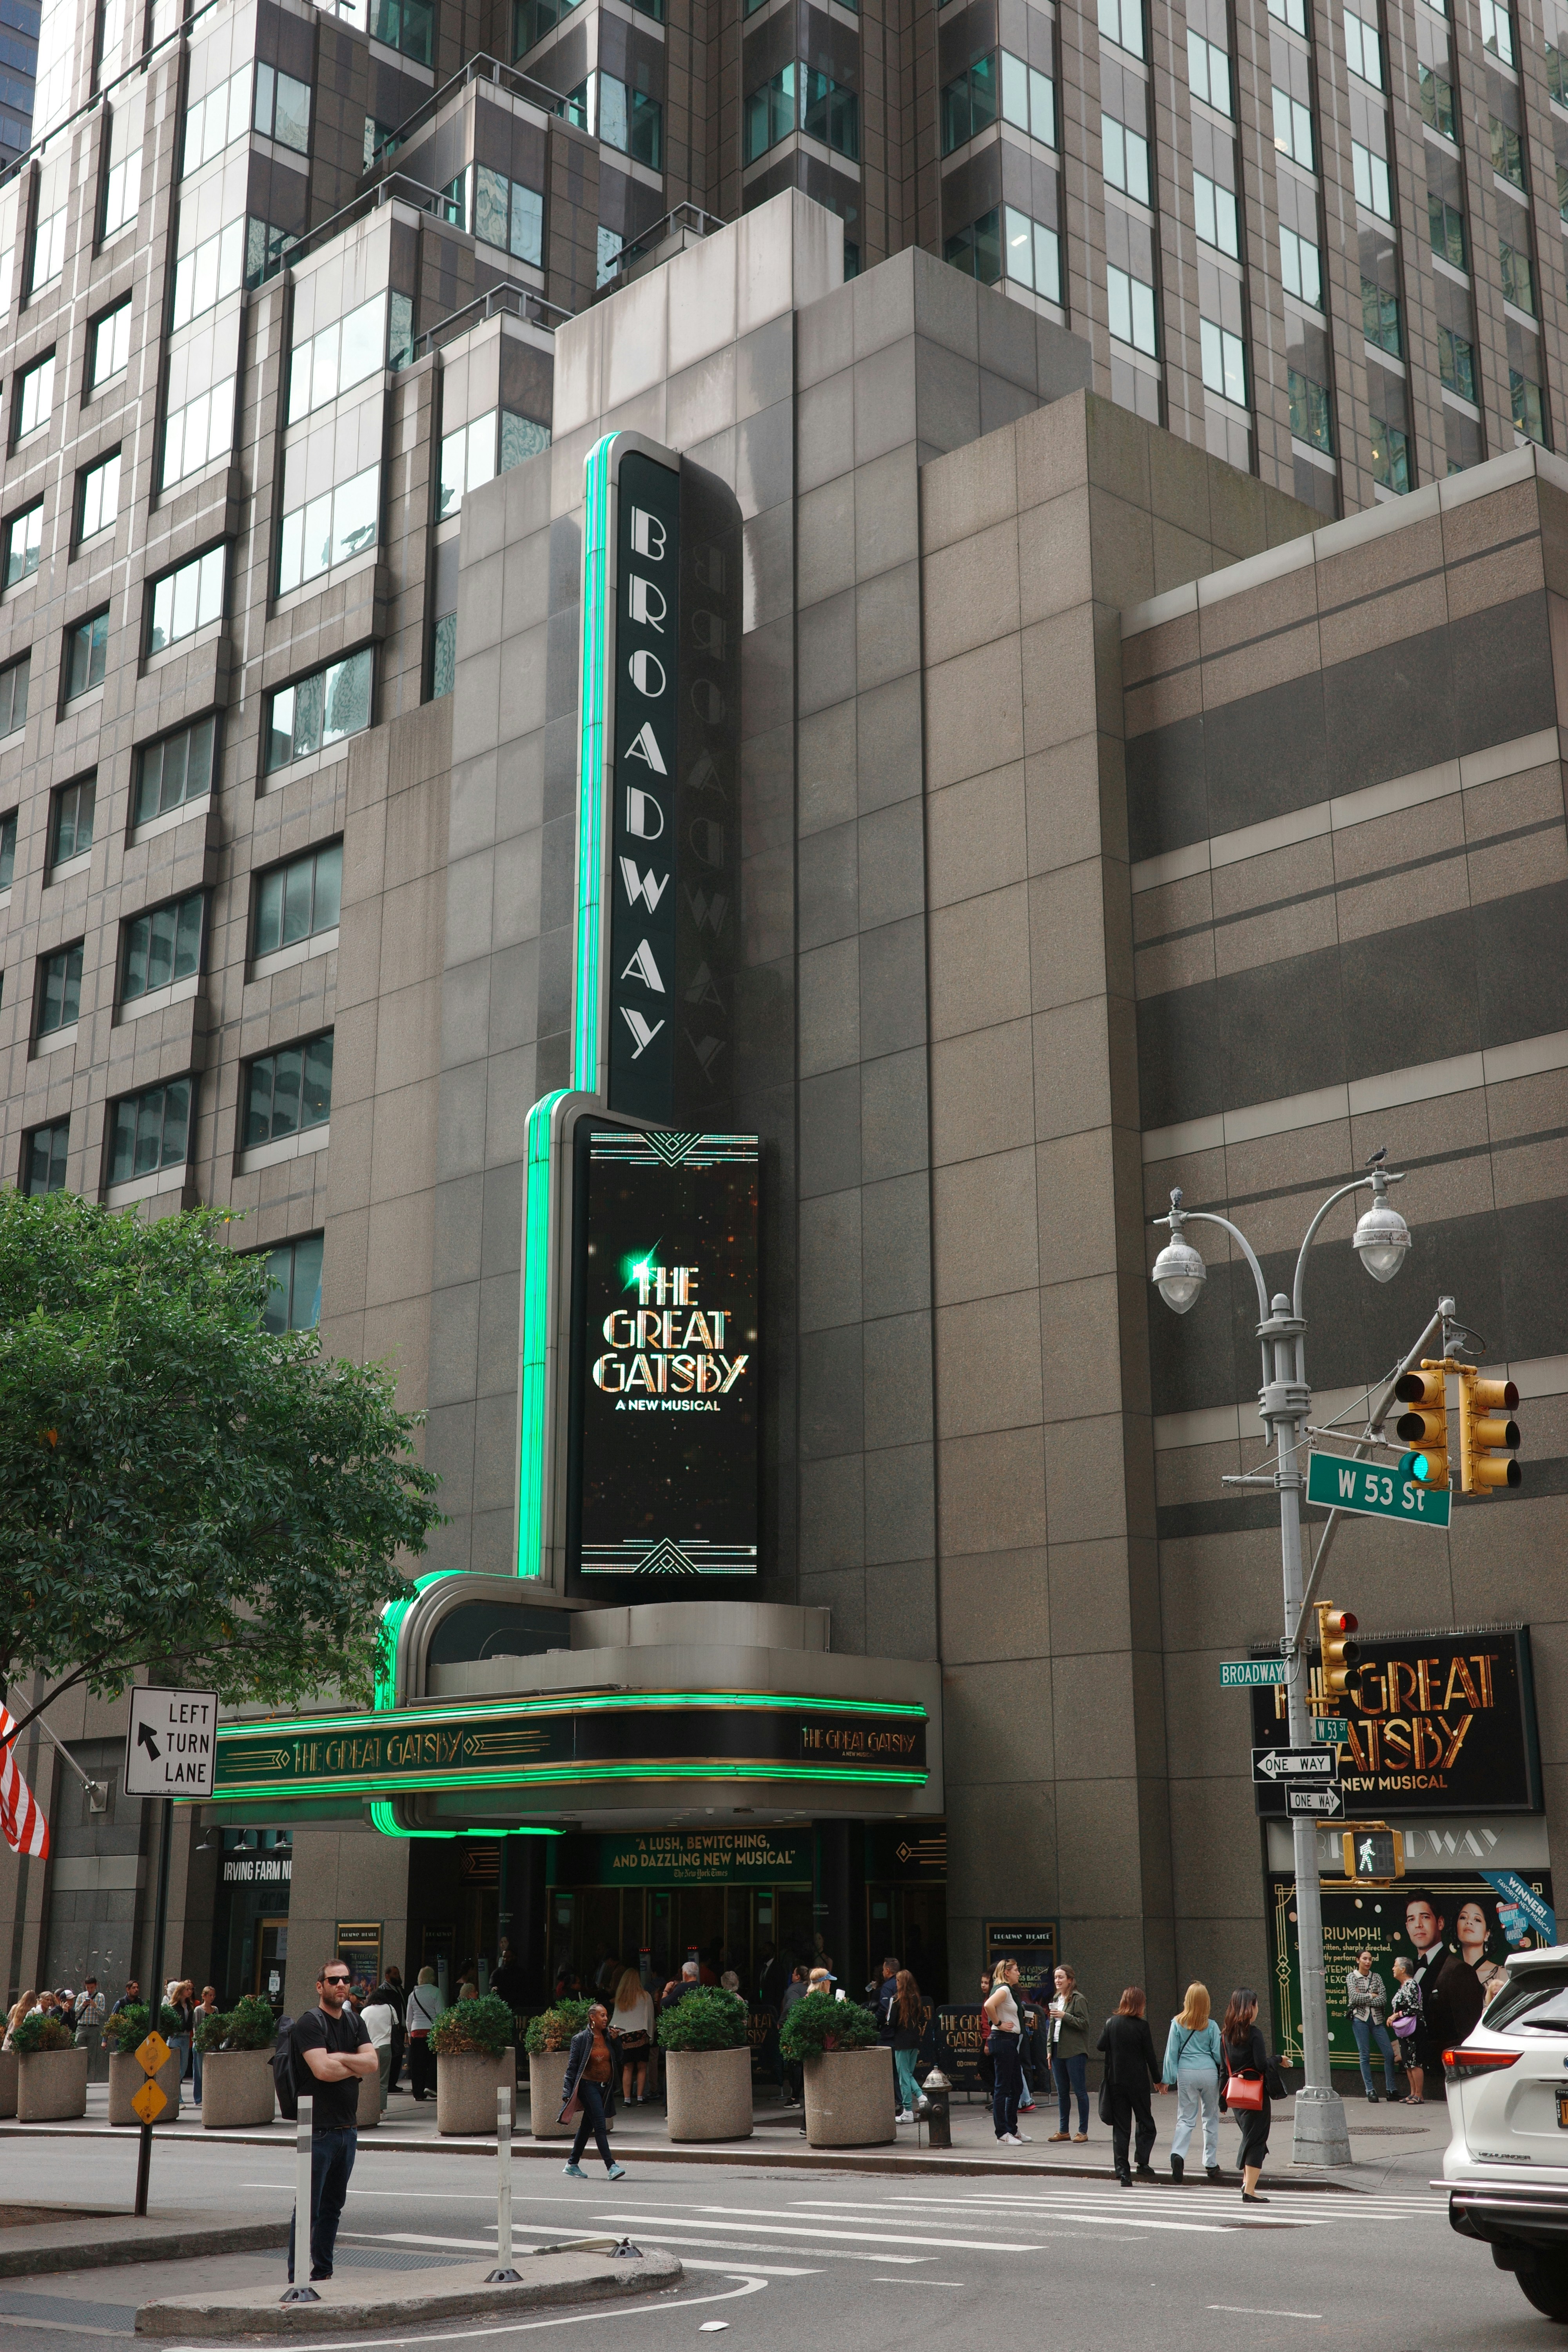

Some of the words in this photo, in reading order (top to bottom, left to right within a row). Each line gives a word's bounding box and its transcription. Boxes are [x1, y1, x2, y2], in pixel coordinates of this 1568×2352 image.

[619, 506, 670, 1060] BROADWAY
[632, 1266, 699, 1305] THE
[603, 1310, 731, 1349] GREAT
[592, 1353, 749, 1393] GATSBY
[615, 1399, 626, 1410] A
[628, 1400, 661, 1410] NEW
[661, 1400, 721, 1411] MUSICAL
[1338, 1468, 1356, 1498] W
[1364, 1474, 1394, 1505] 53
[1401, 1481, 1425, 1512] St
[1222, 1663, 1282, 1683] BROADWAY
[1350, 1655, 1499, 1715] GREAT
[169, 1703, 209, 1724] LEFT
[1318, 1720, 1325, 1739] W
[1328, 1721, 1337, 1739] 53
[1339, 1722, 1346, 1731] ST
[167, 1733, 209, 1753] TURN
[802, 1728, 824, 1748] THE
[826, 1730, 863, 1750] GREAT
[868, 1732, 916, 1753] GATSBY
[1327, 1714, 1473, 1771] ATSBY
[292, 1742, 323, 1772] THE
[326, 1737, 384, 1770] GREAT
[387, 1731, 463, 1766] GATSBY
[165, 1762, 206, 1782] LANE
[1265, 1759, 1289, 1771] ONE
[1300, 1758, 1325, 1770] WAY
[1341, 1776, 1375, 1791] NEW
[1379, 1774, 1448, 1791] MUSICAL
[1295, 1795, 1312, 1807] ONE
[1318, 1795, 1335, 1808] WAY
[650, 1837, 683, 1851] LUSH,
[687, 1835, 770, 1849] BEWITCHING,
[1316, 1828, 1503, 1859] BRDWAY
[613, 1855, 638, 1867] AND
[641, 1853, 701, 1867] DAZZLING
[704, 1853, 732, 1866] NEW
[223, 1861, 254, 1880] IRVING
[255, 1861, 281, 1880] FARM
[696, 1869, 710, 1879] York
[711, 1868, 728, 1877] Times
[1508, 1876, 1547, 1918] WINNER!
[1497, 1878, 1521, 1902] FAVORITE
[1519, 1900, 1532, 1913] NEW
[1530, 1911, 1552, 1935] MUSICAL
[1500, 1909, 1519, 1922] AUDIENCE
[1513, 1917, 1527, 1929] CHOICE
[1321, 1927, 1381, 1940] RIUMPH!
[1506, 1928, 1523, 1941] AWARDS
[1323, 1943, 1341, 1951] ritten,
[1342, 1942, 1364, 1953] sharply
[1365, 1942, 1392, 1952] directed,
[1333, 1952, 1356, 1963] perform
[1027, 1966, 1049, 1974] GATSBY
[1326, 1965, 1357, 1973] TEEMIN
[1325, 1986, 1346, 1994] musical
[1339, 1996, 1347, 2004] off
[748, 2014, 772, 2028] REAT
[939, 2014, 958, 2031] THE
[960, 2015, 982, 2031] GRE
[946, 2031, 983, 2047] GATSB
[1478, 2152, 1531, 2160] HIGHLANDER
